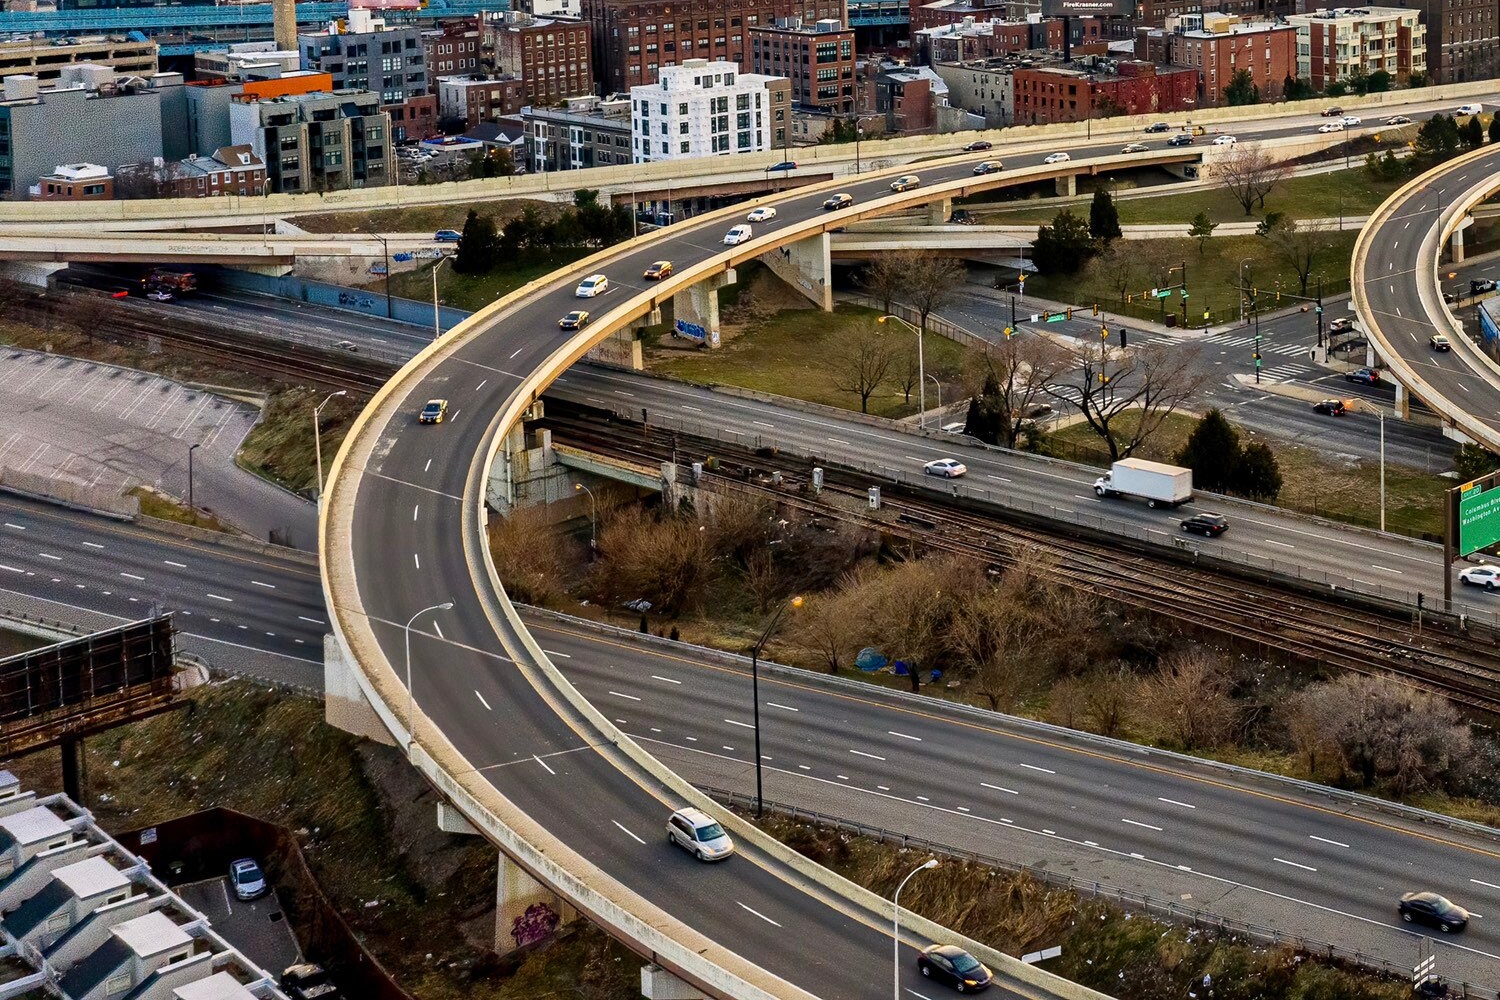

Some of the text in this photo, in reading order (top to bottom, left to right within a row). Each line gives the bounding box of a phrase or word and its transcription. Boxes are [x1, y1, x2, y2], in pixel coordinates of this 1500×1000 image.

[1472, 487, 1480, 495] 20
[1465, 502, 1490, 516] Columbus
[1462, 509, 1492, 525] Washington
